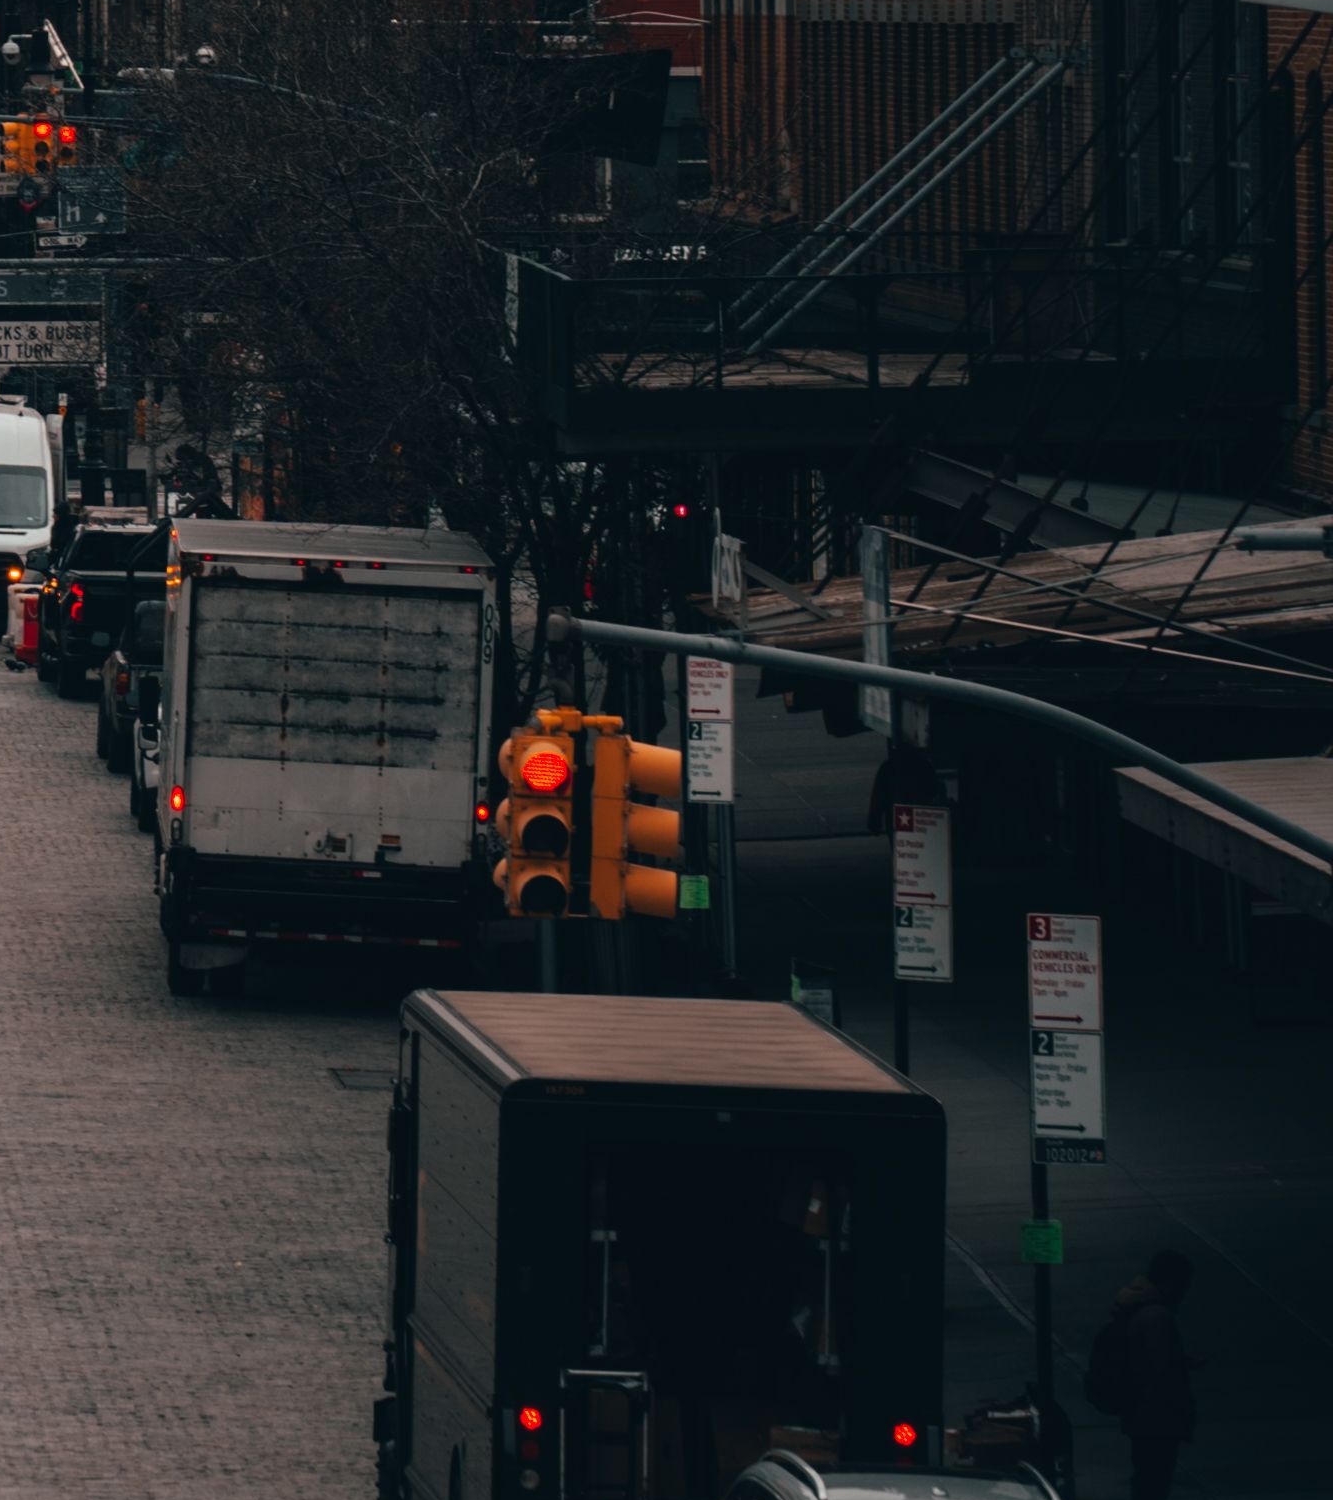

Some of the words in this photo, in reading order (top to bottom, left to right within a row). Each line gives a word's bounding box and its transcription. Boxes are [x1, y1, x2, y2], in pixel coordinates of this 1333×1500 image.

[16, 345, 53, 358] TURN
[483, 604, 493, 664] 009
[691, 723, 699, 739] 2
[899, 908, 909, 926] 2
[1035, 917, 1046, 939] 3
[1033, 949, 1090, 961] COMMERCIAL
[1033, 961, 1074, 974] VEHICLES
[1076, 964, 1097, 975] ONLY
[1037, 1032, 1049, 1054] 2
